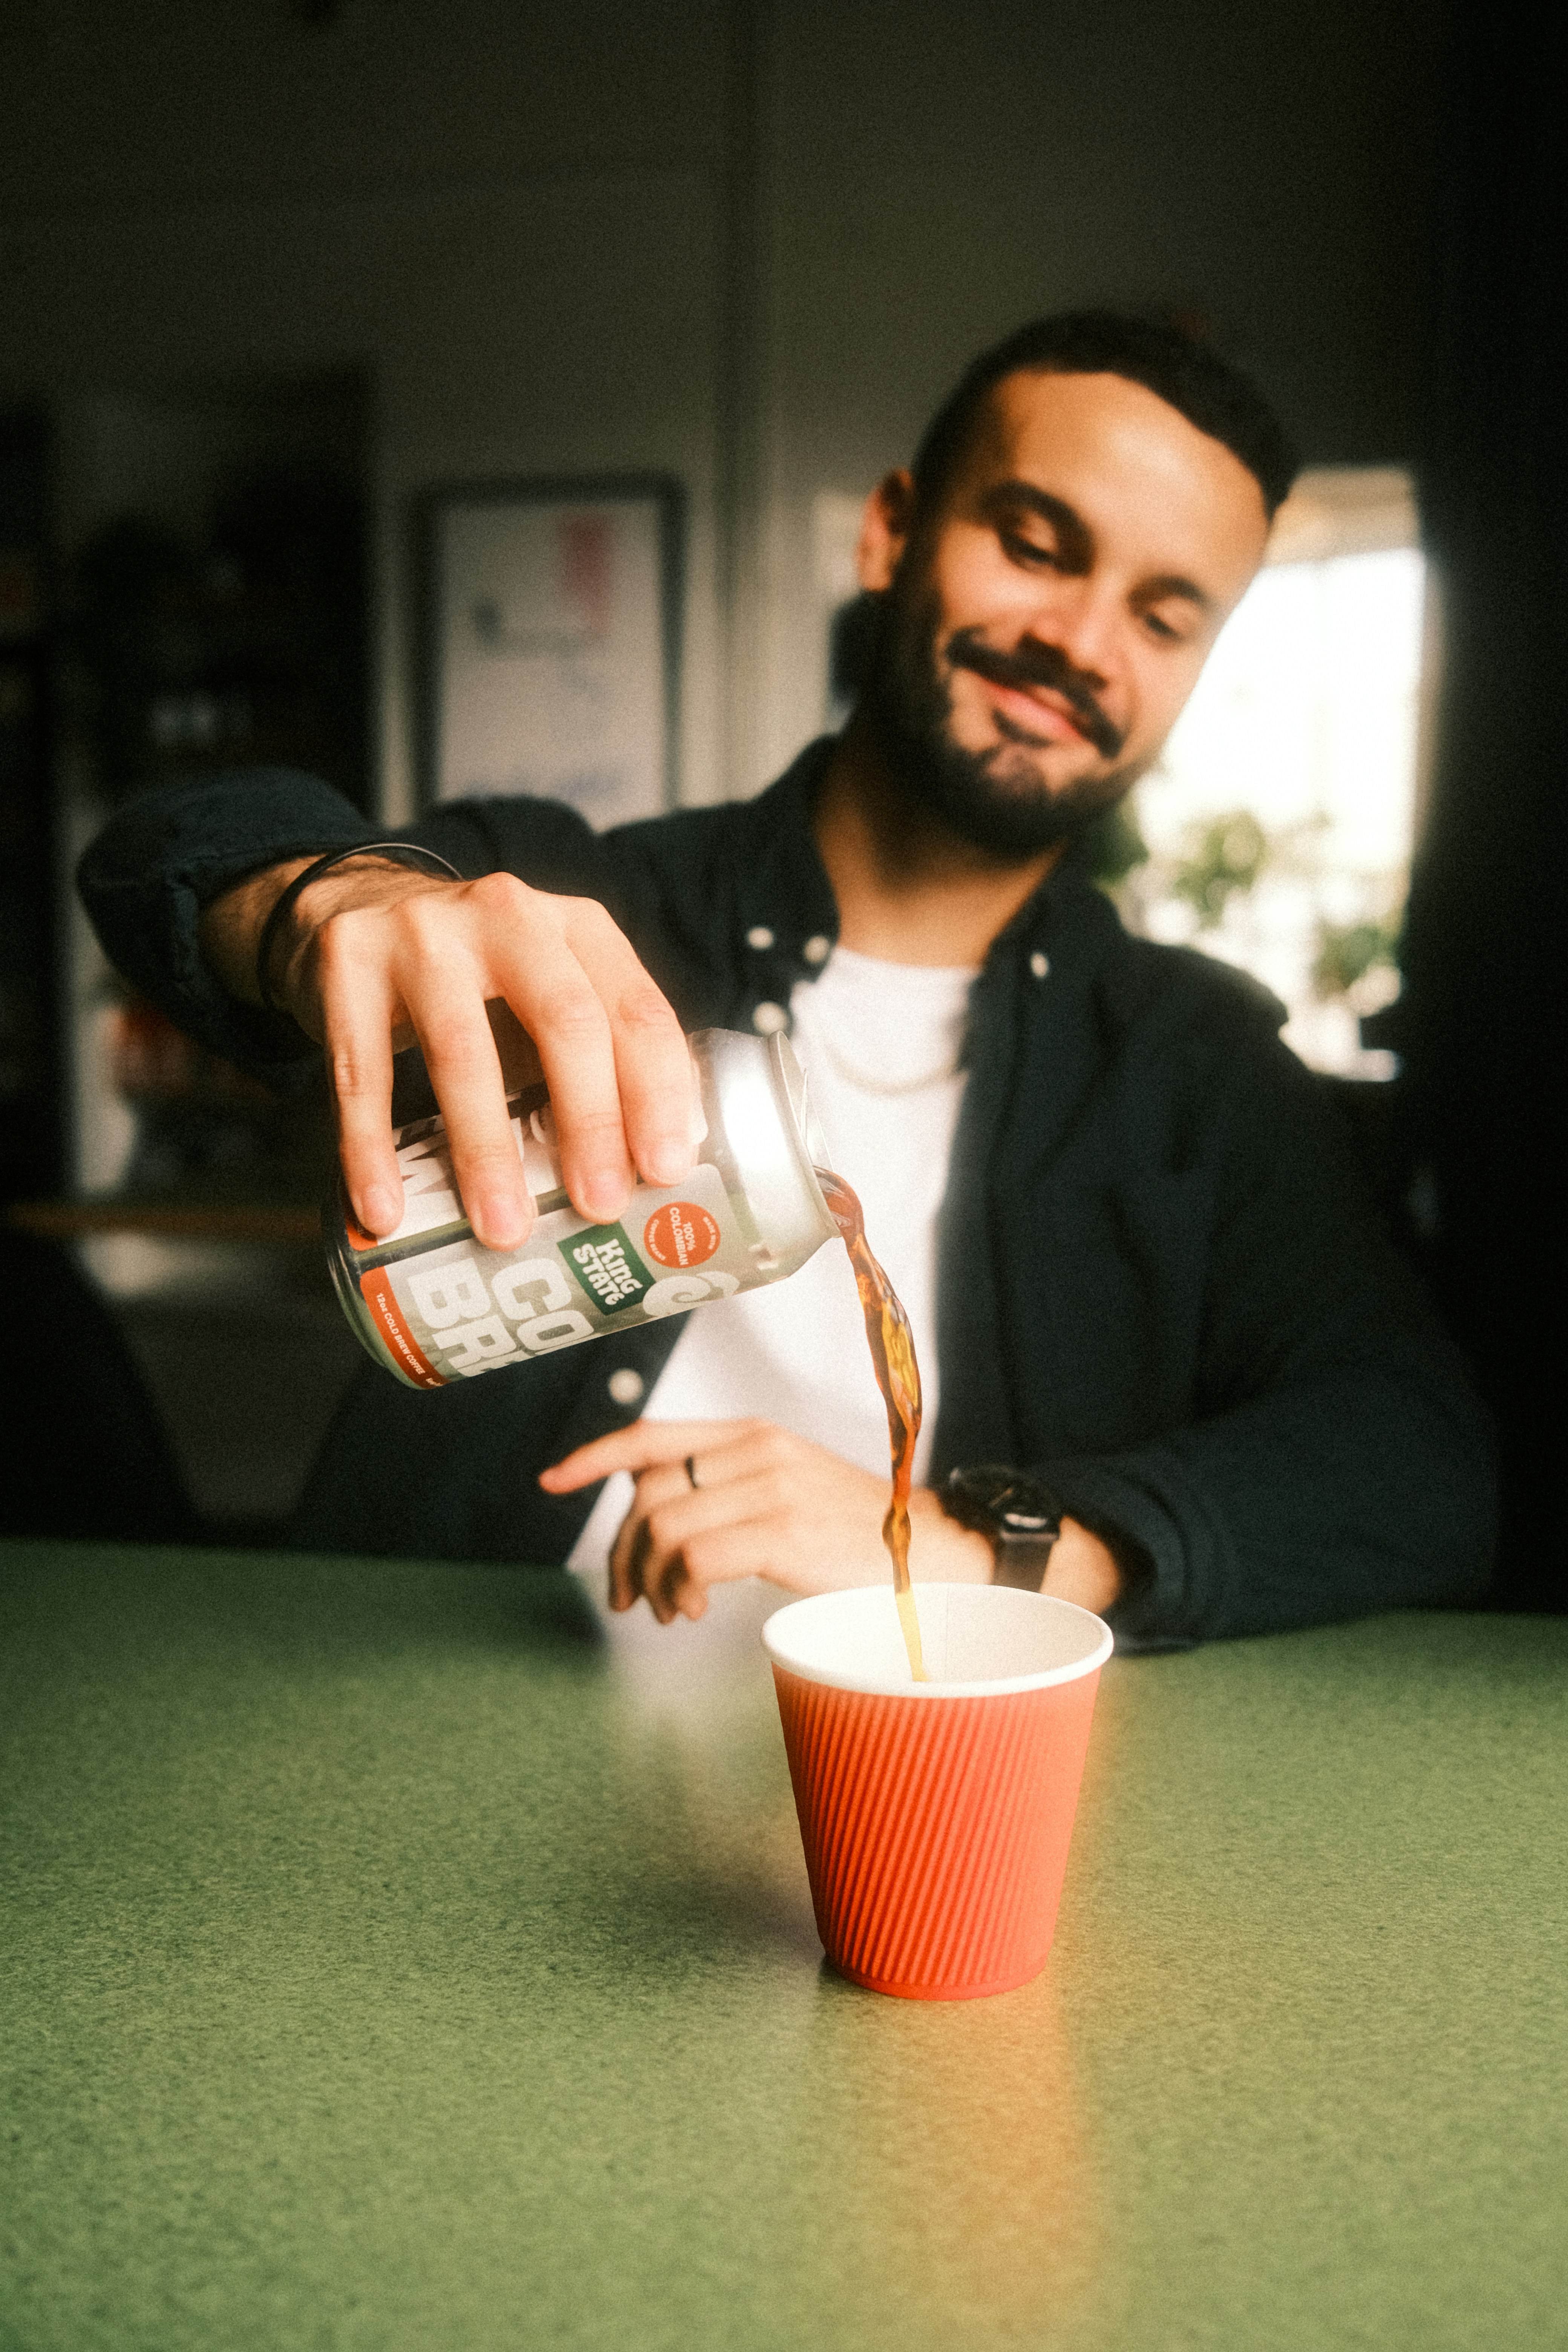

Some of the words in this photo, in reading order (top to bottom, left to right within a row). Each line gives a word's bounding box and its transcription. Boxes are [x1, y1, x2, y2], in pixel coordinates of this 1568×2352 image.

[648, 1219, 660, 1243] COFFEE
[669, 1207, 689, 1266] COLOMBIAN
[683, 1222, 696, 1251] 100%
[703, 1216, 716, 1234] MADE
[650, 1243, 666, 1261] BEANS
[708, 1234, 716, 1250] WITH
[377, 1293, 388, 1312] 12oz
[384, 1312, 400, 1335] COLD
[395, 1335, 412, 1355] BREW
[406, 1355, 426, 1375] COFFEE
